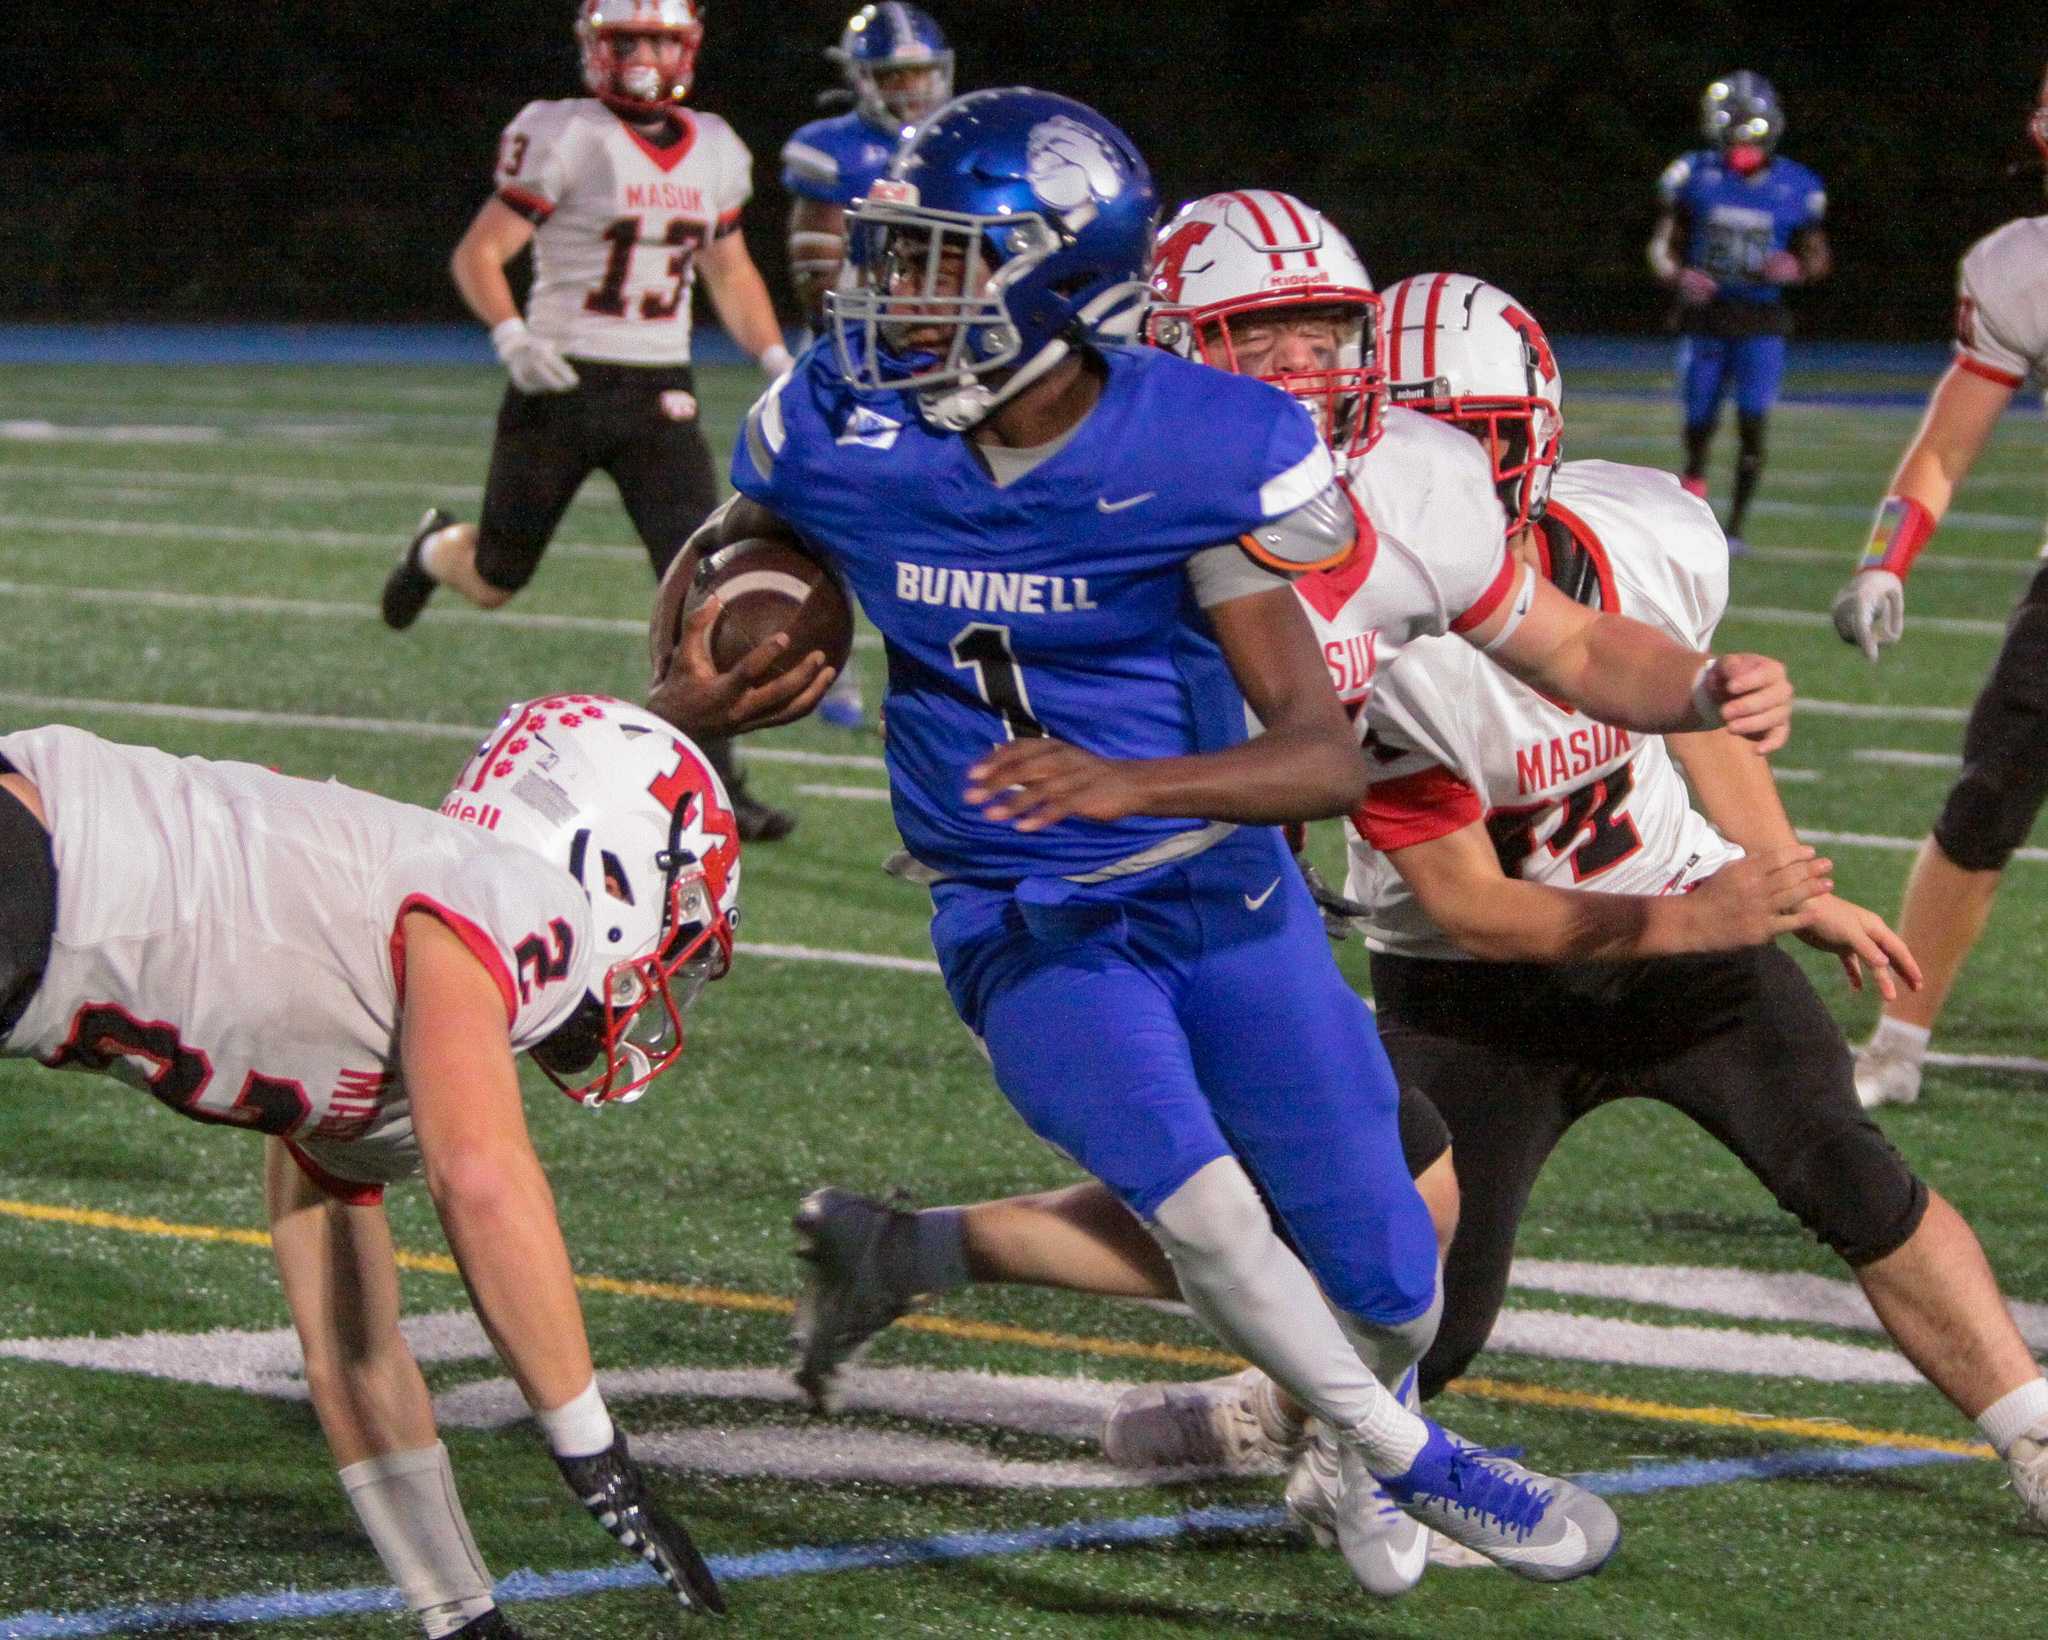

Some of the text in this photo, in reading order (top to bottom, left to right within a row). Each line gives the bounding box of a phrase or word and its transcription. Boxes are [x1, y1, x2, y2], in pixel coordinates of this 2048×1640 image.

[584, 213, 710, 321] 13
[896, 561, 1098, 614] BUNNELL
[948, 621, 1051, 745] 1
[1324, 628, 1379, 692] SUK
